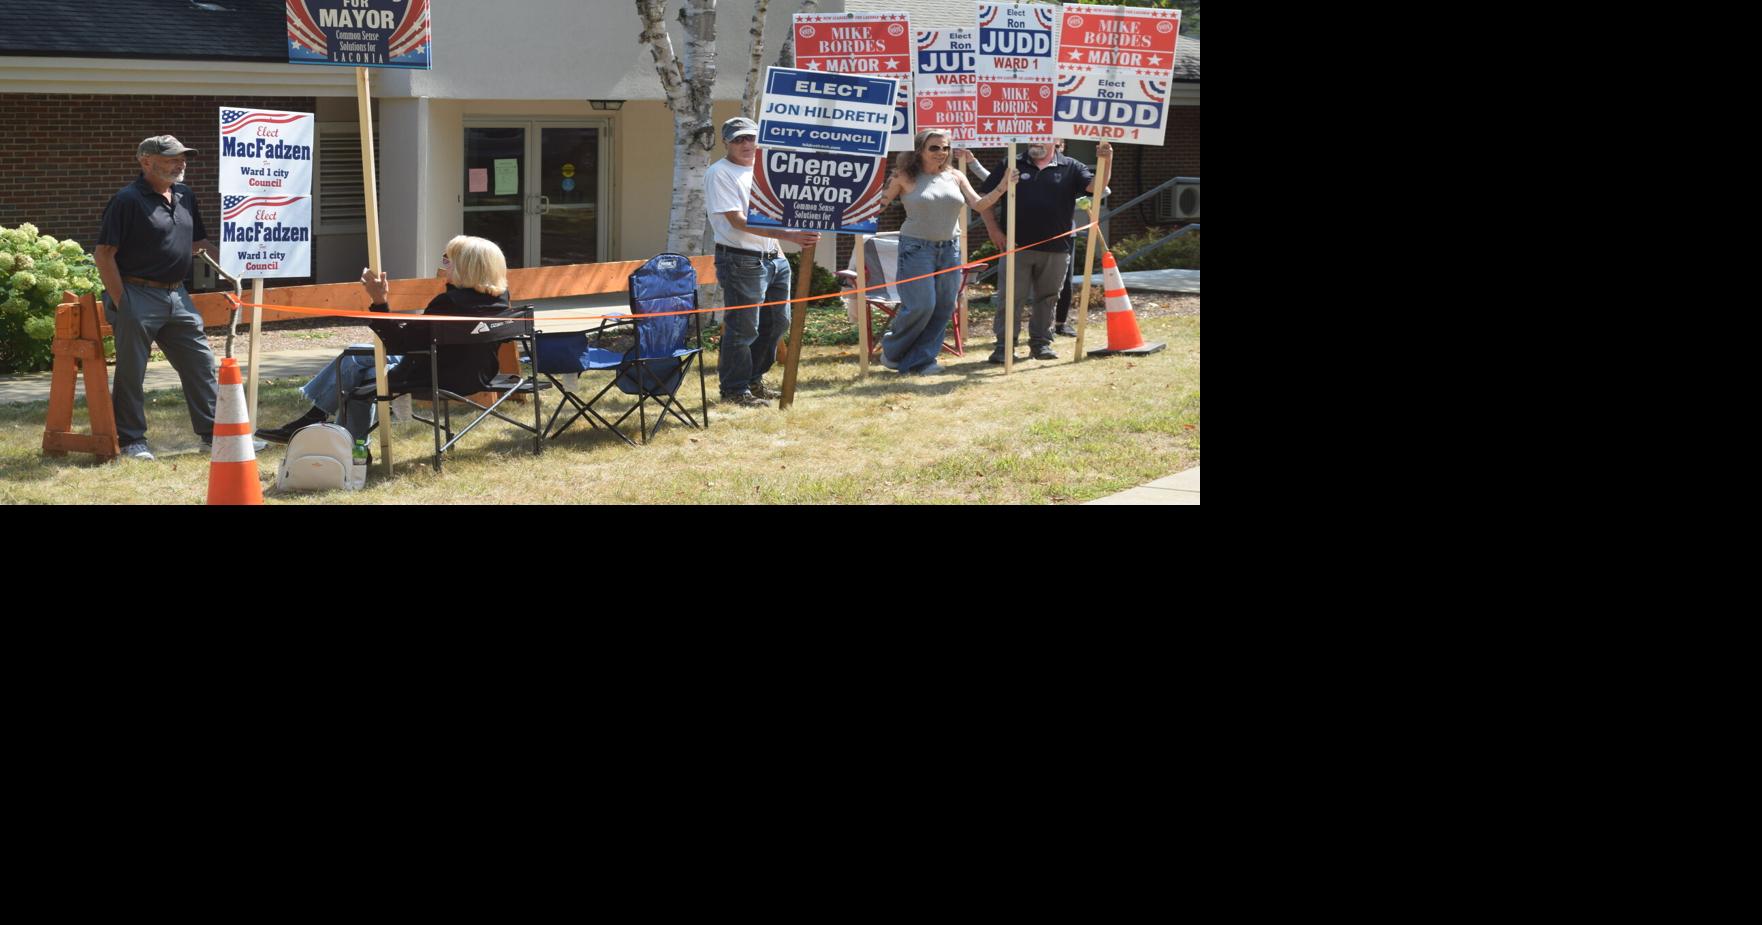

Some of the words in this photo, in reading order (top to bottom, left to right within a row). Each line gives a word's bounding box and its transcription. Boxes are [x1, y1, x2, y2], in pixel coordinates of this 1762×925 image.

[344, 0, 368, 8] FOR
[319, 8, 394, 29] MAYOR
[1007, 9, 1025, 17] Elect
[1007, 19, 1025, 28] Ron
[1098, 19, 1140, 34] MIKE
[336, 30, 362, 40] Common
[362, 31, 380, 40] Sense
[831, 26, 872, 40] MIKE
[950, 41, 972, 49] Ron
[981, 30, 1050, 54] JUDD
[1084, 32, 1152, 48] BORDES
[340, 42, 366, 52] Solutions
[368, 43, 376, 52] for
[819, 40, 886, 54] BORDES
[334, 52, 384, 64] LACONIA
[920, 52, 975, 72] JUD
[994, 57, 1029, 69] WARD
[1033, 59, 1038, 70] 1
[1088, 50, 1142, 66] MAYOR
[826, 58, 880, 72] MAYOR
[936, 74, 976, 84] WARD
[1098, 79, 1126, 88] Elect
[795, 80, 868, 98] ELECT
[1002, 88, 1030, 100] MIKE
[1097, 88, 1124, 99] Ron
[993, 100, 1038, 113] BORDES
[766, 102, 800, 116] JON
[804, 106, 888, 124] HILDRETH
[936, 111, 976, 123] BORD
[1058, 100, 1159, 126] JUDD
[256, 126, 279, 138] Elect
[997, 119, 1032, 133] MAYOR
[1073, 124, 1125, 138] WARD
[1131, 128, 1140, 140] 1
[770, 127, 806, 137] CITY
[810, 130, 876, 144] COUNCIL
[950, 127, 975, 140] AYO
[222, 136, 310, 160] MacFadzen
[240, 167, 264, 176] Ward
[267, 168, 271, 176] 1
[273, 169, 289, 179] city
[770, 152, 870, 182] Cheney
[249, 178, 282, 187] Council
[805, 176, 830, 186] FOR
[780, 184, 853, 204] MAYOR
[793, 202, 817, 211] Common
[818, 202, 835, 212] Sense
[255, 210, 277, 221] Elect
[794, 211, 822, 220] Solutions
[822, 212, 832, 221] for
[788, 218, 835, 230] LACONIA
[223, 222, 309, 242] MacFadzen
[238, 251, 260, 260] Ward
[263, 251, 267, 260] 1
[269, 251, 286, 261] city
[246, 261, 278, 271] Council
